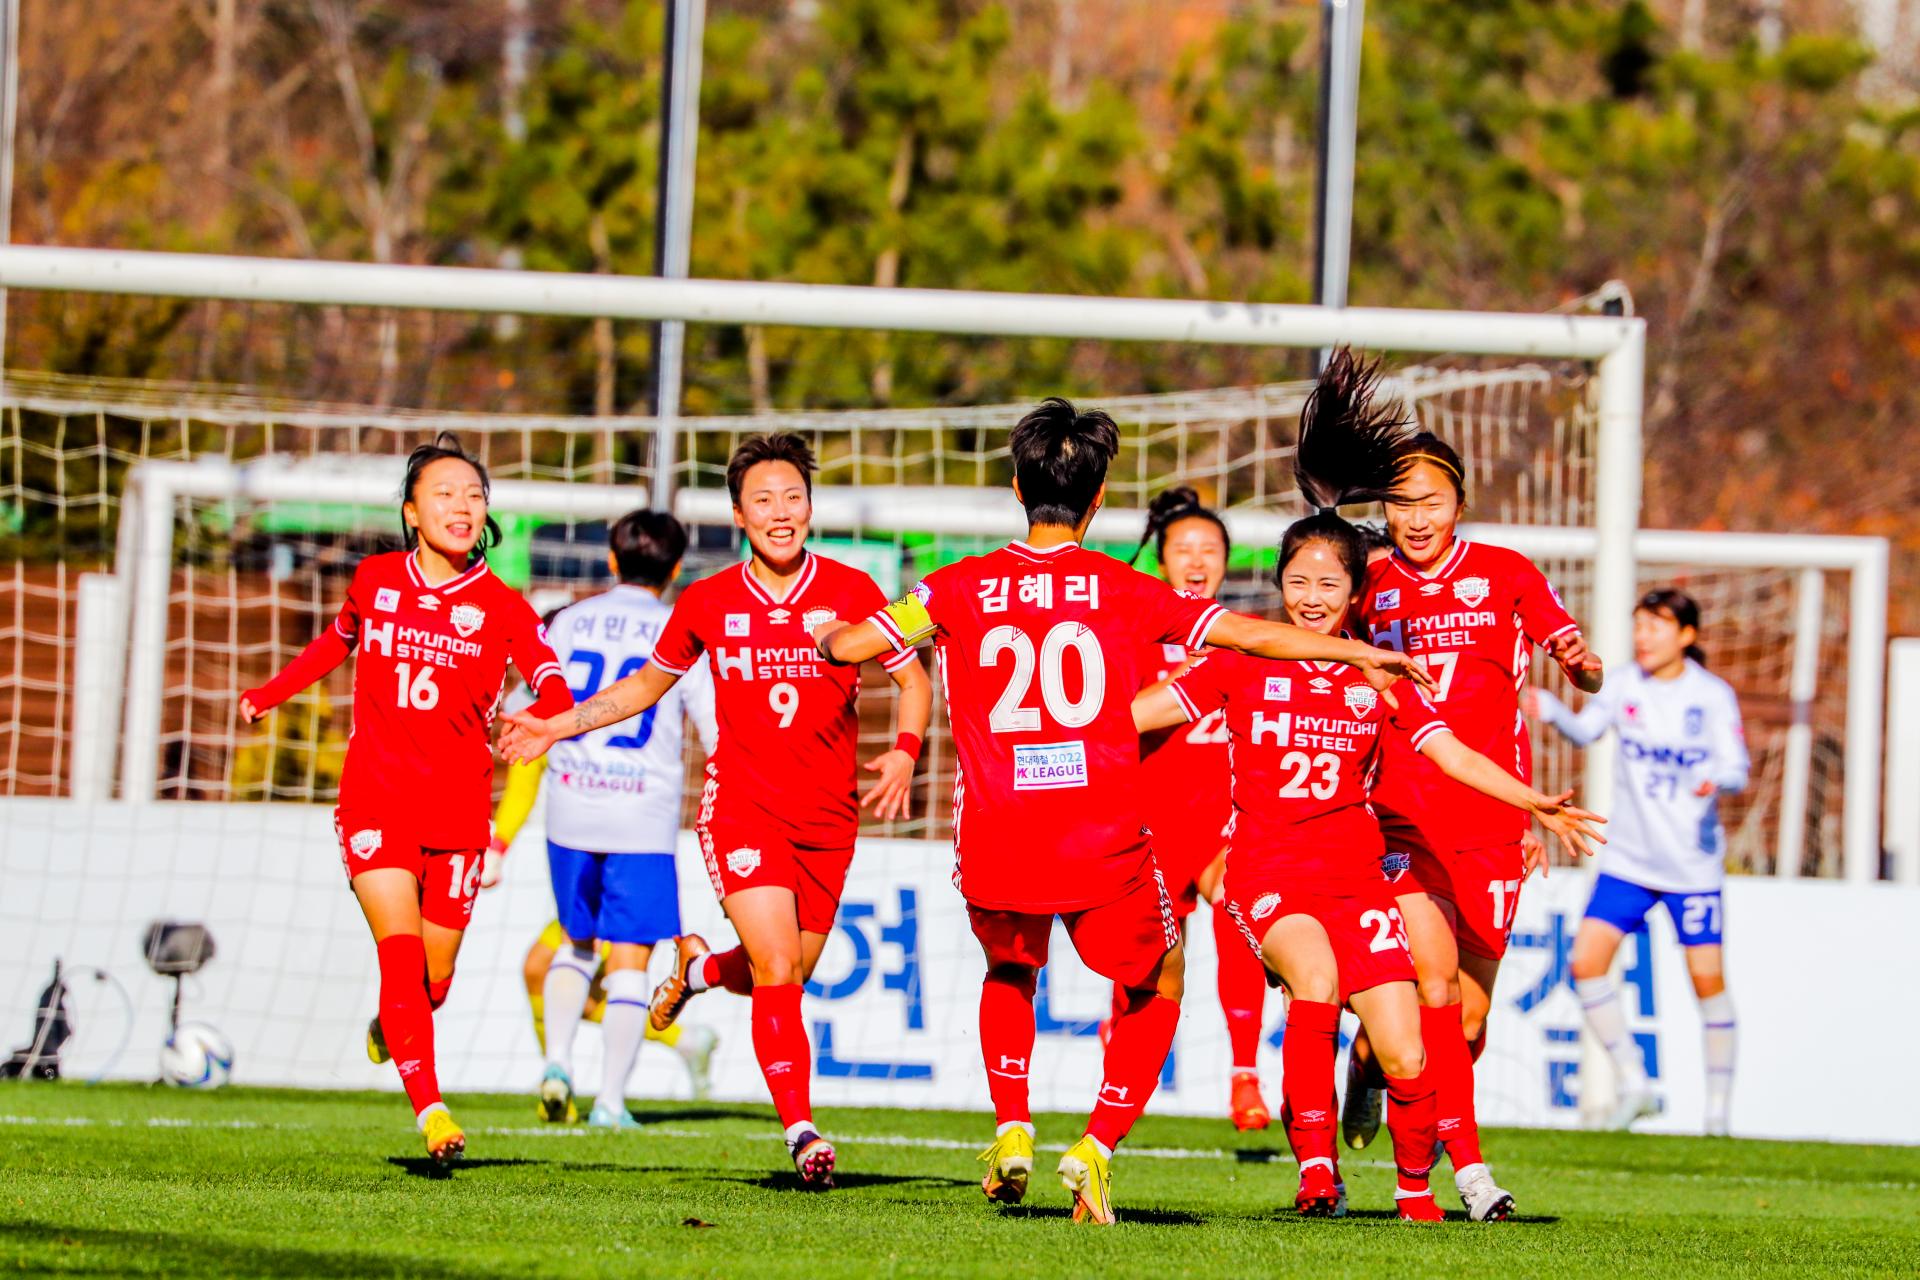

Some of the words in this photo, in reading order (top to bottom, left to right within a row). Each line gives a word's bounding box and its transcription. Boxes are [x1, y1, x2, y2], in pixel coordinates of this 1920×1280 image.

[977, 573, 1099, 613] 김혜리
[1407, 611, 1496, 633] HYUNDAI
[397, 626, 482, 657] HYUNDAI
[1409, 630, 1477, 650] STEEL
[396, 643, 458, 669] STEEL
[758, 664, 823, 679] STEEL
[394, 662, 440, 710] 16
[979, 621, 1106, 733] 20
[768, 682, 799, 728] 9
[1295, 715, 1377, 735] HYUNDAI
[1051, 751, 1083, 764] 2022
[1294, 733, 1357, 752] STEEL
[1032, 764, 1085, 778] LEAGUE
[1279, 751, 1341, 800] 23
[448, 854, 481, 899] 16
[1487, 879, 1521, 929] 17
[1682, 895, 1721, 935] 27
